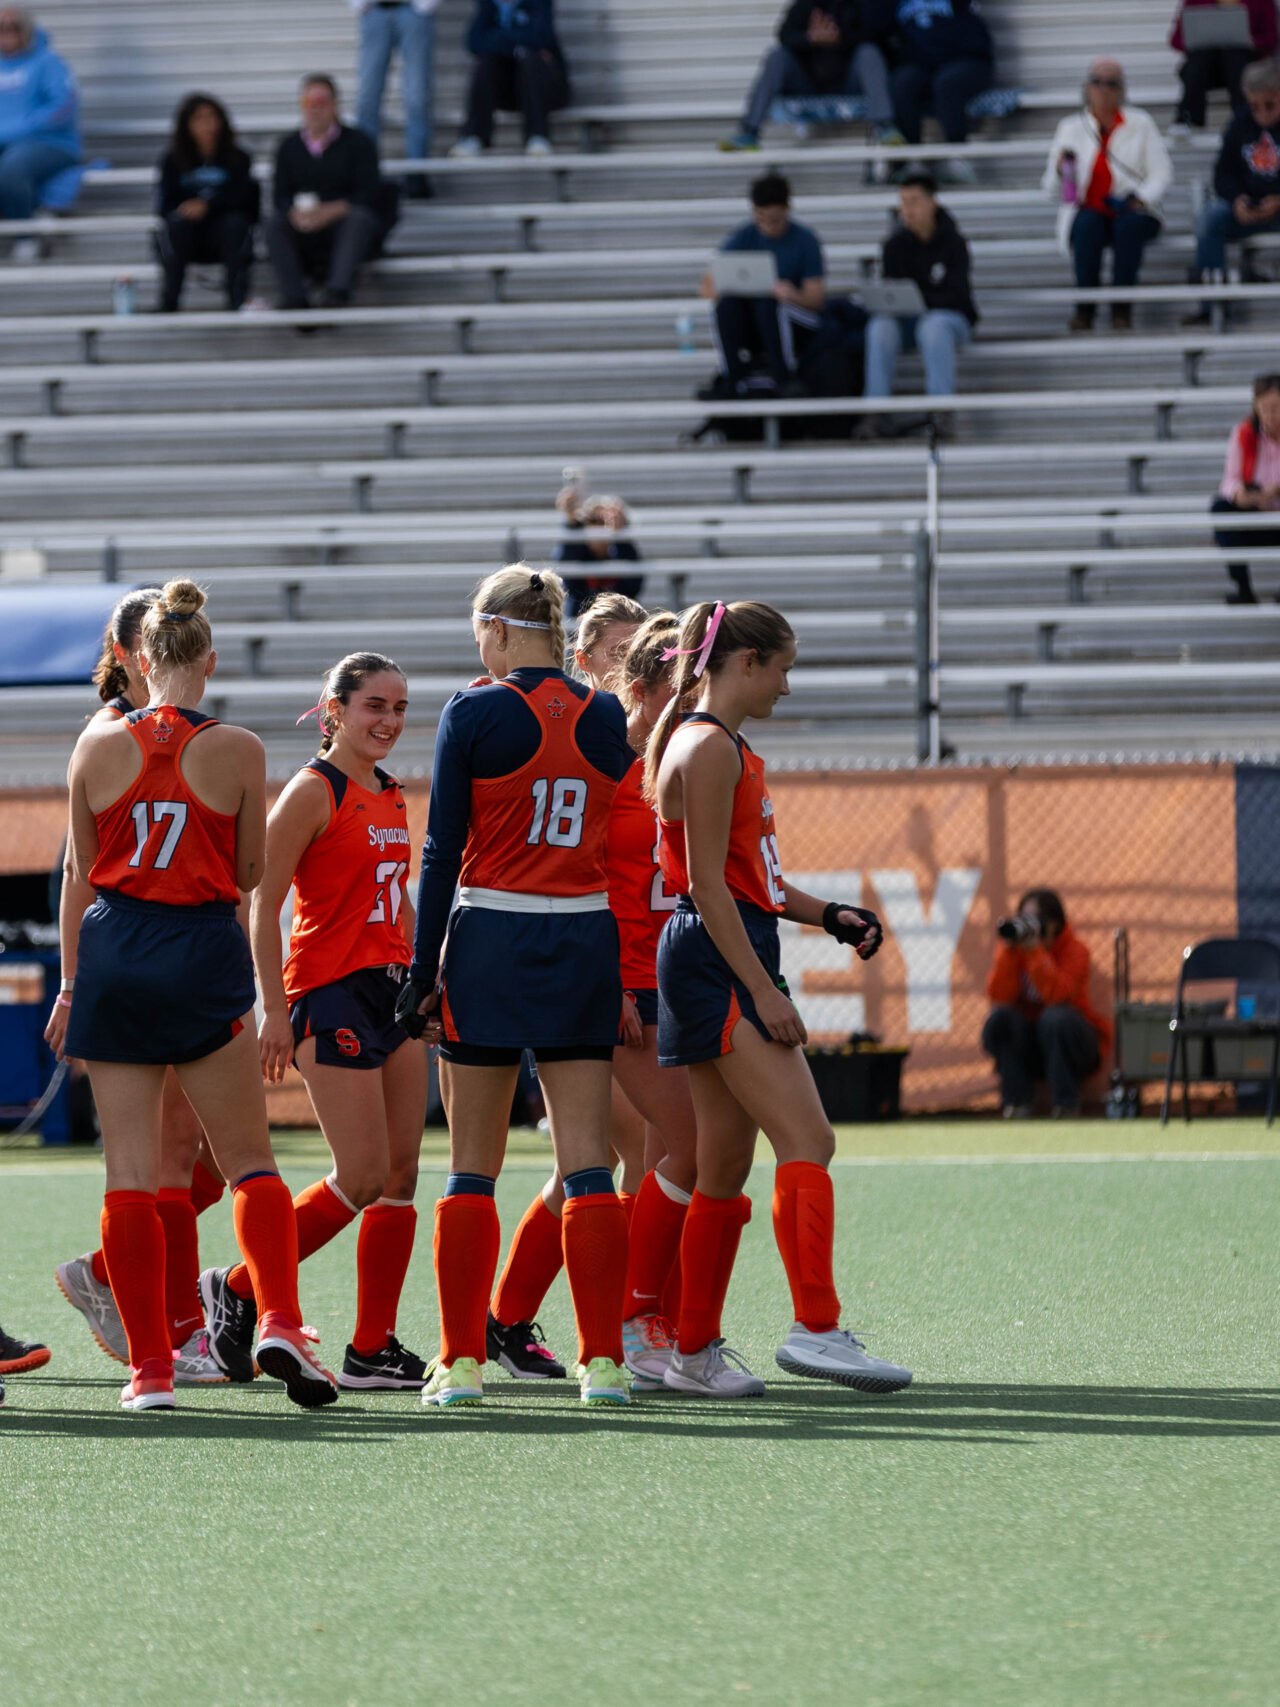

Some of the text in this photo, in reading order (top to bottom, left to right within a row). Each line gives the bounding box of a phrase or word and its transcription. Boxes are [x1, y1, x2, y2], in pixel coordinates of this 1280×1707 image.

[128, 801, 188, 870] 17
[526, 776, 588, 849] 18
[335, 1028, 361, 1057] S
